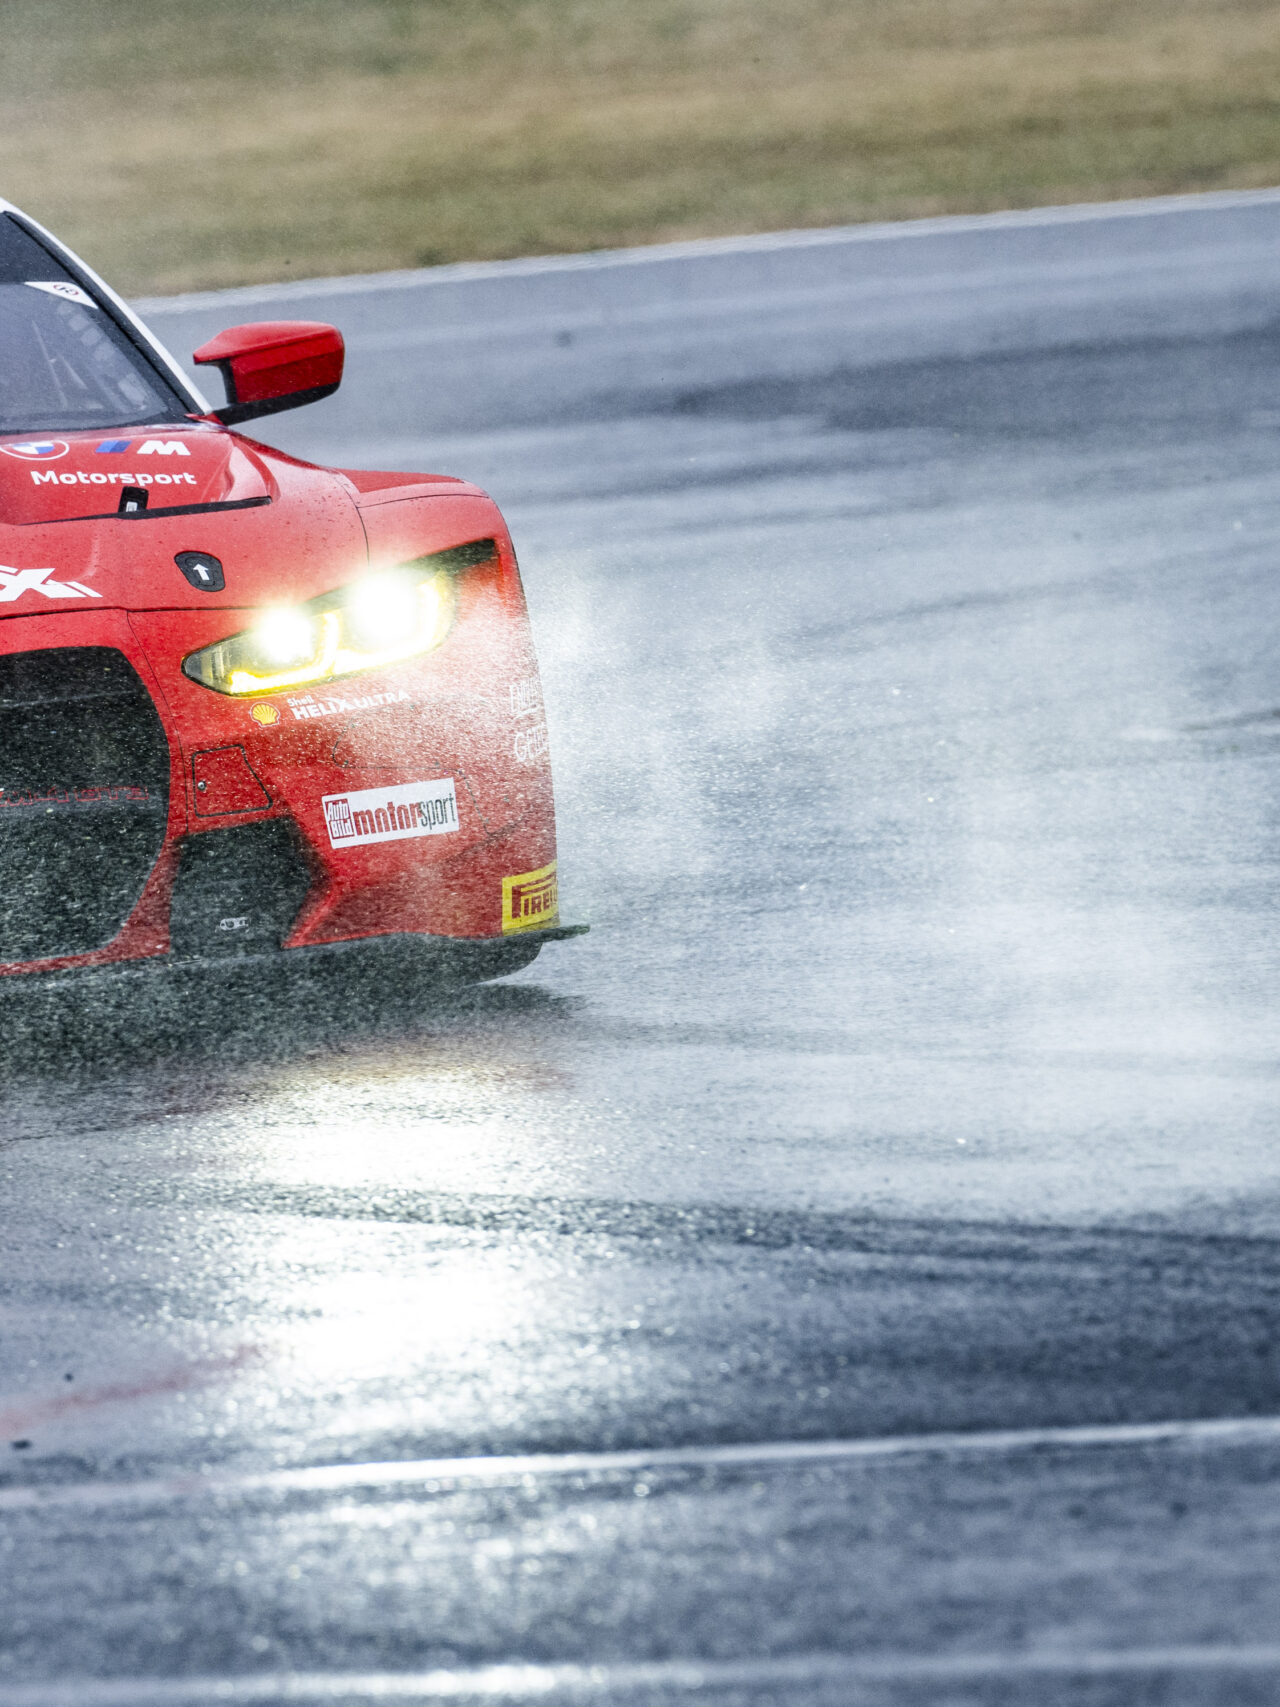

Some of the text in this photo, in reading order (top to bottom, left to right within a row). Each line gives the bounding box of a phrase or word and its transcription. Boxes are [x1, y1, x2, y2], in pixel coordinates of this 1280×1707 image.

[137, 440, 192, 456] M
[30, 470, 198, 487] Motorsport
[287, 694, 315, 708] Shell
[291, 697, 356, 720] HELIX
[326, 800, 350, 821] Auto
[353, 793, 457, 835] motorsport
[330, 819, 354, 839] Bild
